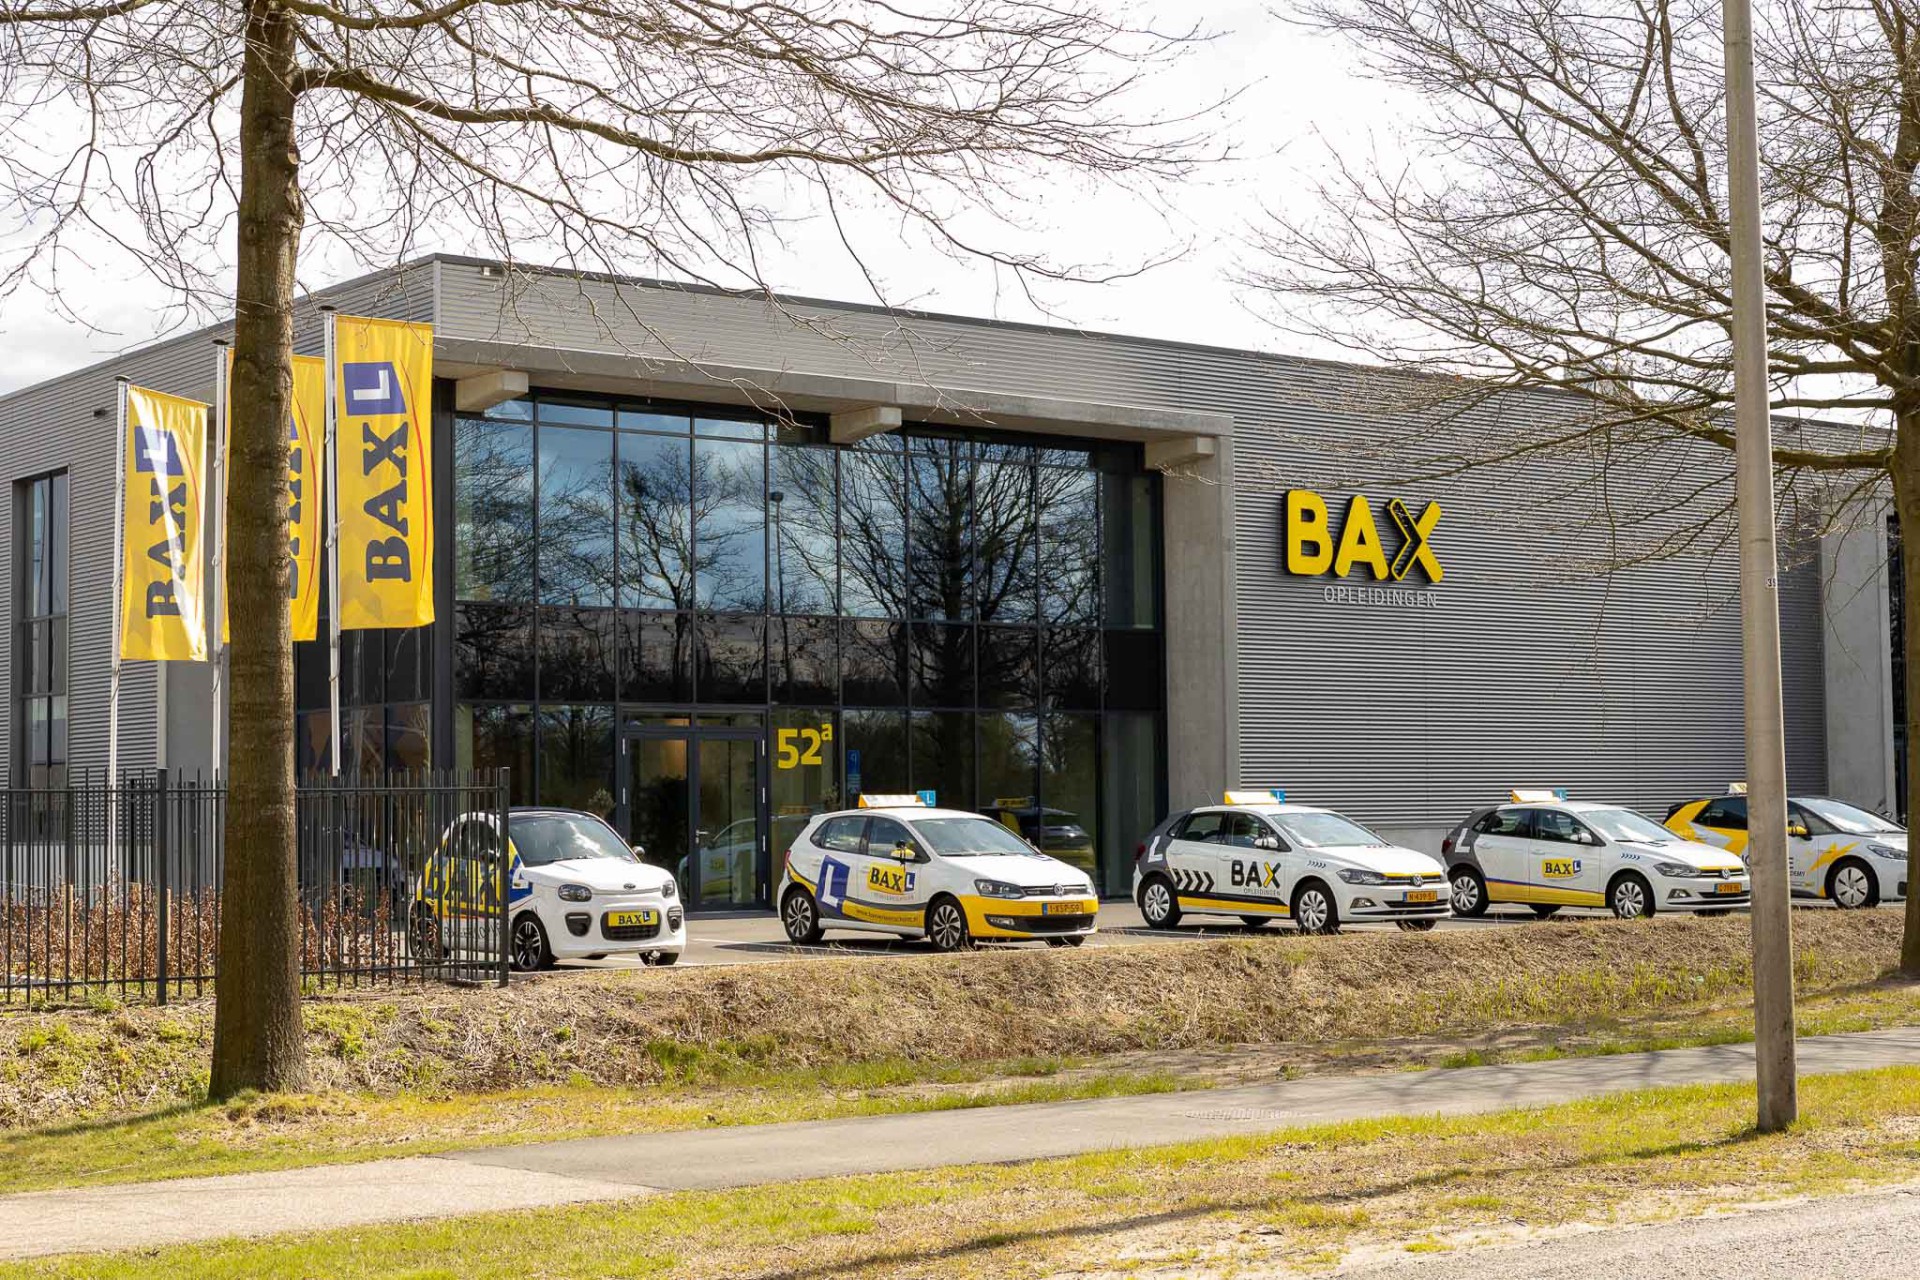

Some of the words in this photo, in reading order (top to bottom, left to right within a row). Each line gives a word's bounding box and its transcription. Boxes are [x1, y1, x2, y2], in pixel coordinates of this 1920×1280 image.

[353, 370, 391, 400] L
[363, 421, 411, 583] BAX
[146, 478, 187, 619] BAX
[1286, 488, 1444, 583] BAX
[1323, 585, 1439, 609] OPLEIDINGEN
[870, 866, 903, 893] BAX
[1231, 859, 1282, 889] BAX
[1544, 862, 1572, 875] BAX
[821, 863, 839, 908] L
[618, 914, 642, 925] BAX
